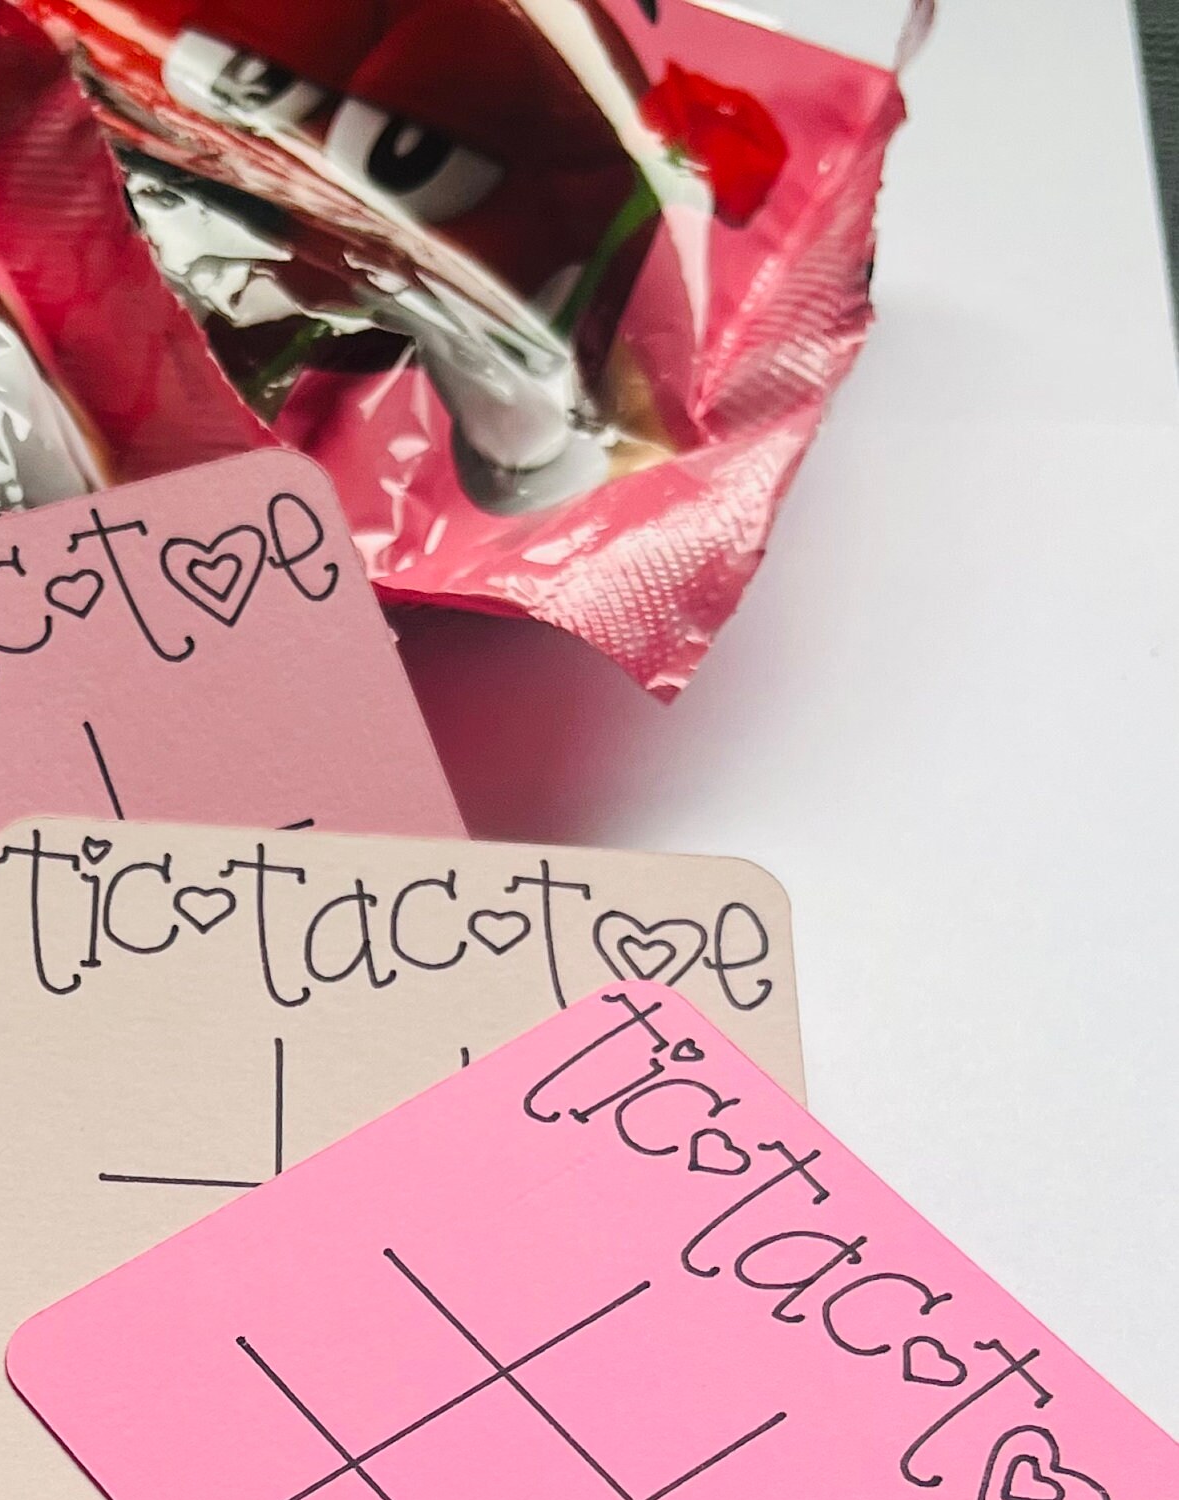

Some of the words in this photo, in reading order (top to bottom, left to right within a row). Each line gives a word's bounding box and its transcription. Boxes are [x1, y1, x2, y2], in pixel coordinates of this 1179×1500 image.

[219, 843, 468, 1006] tac
[522, 993, 740, 1156] tic
[682, 1140, 952, 1357] tac
